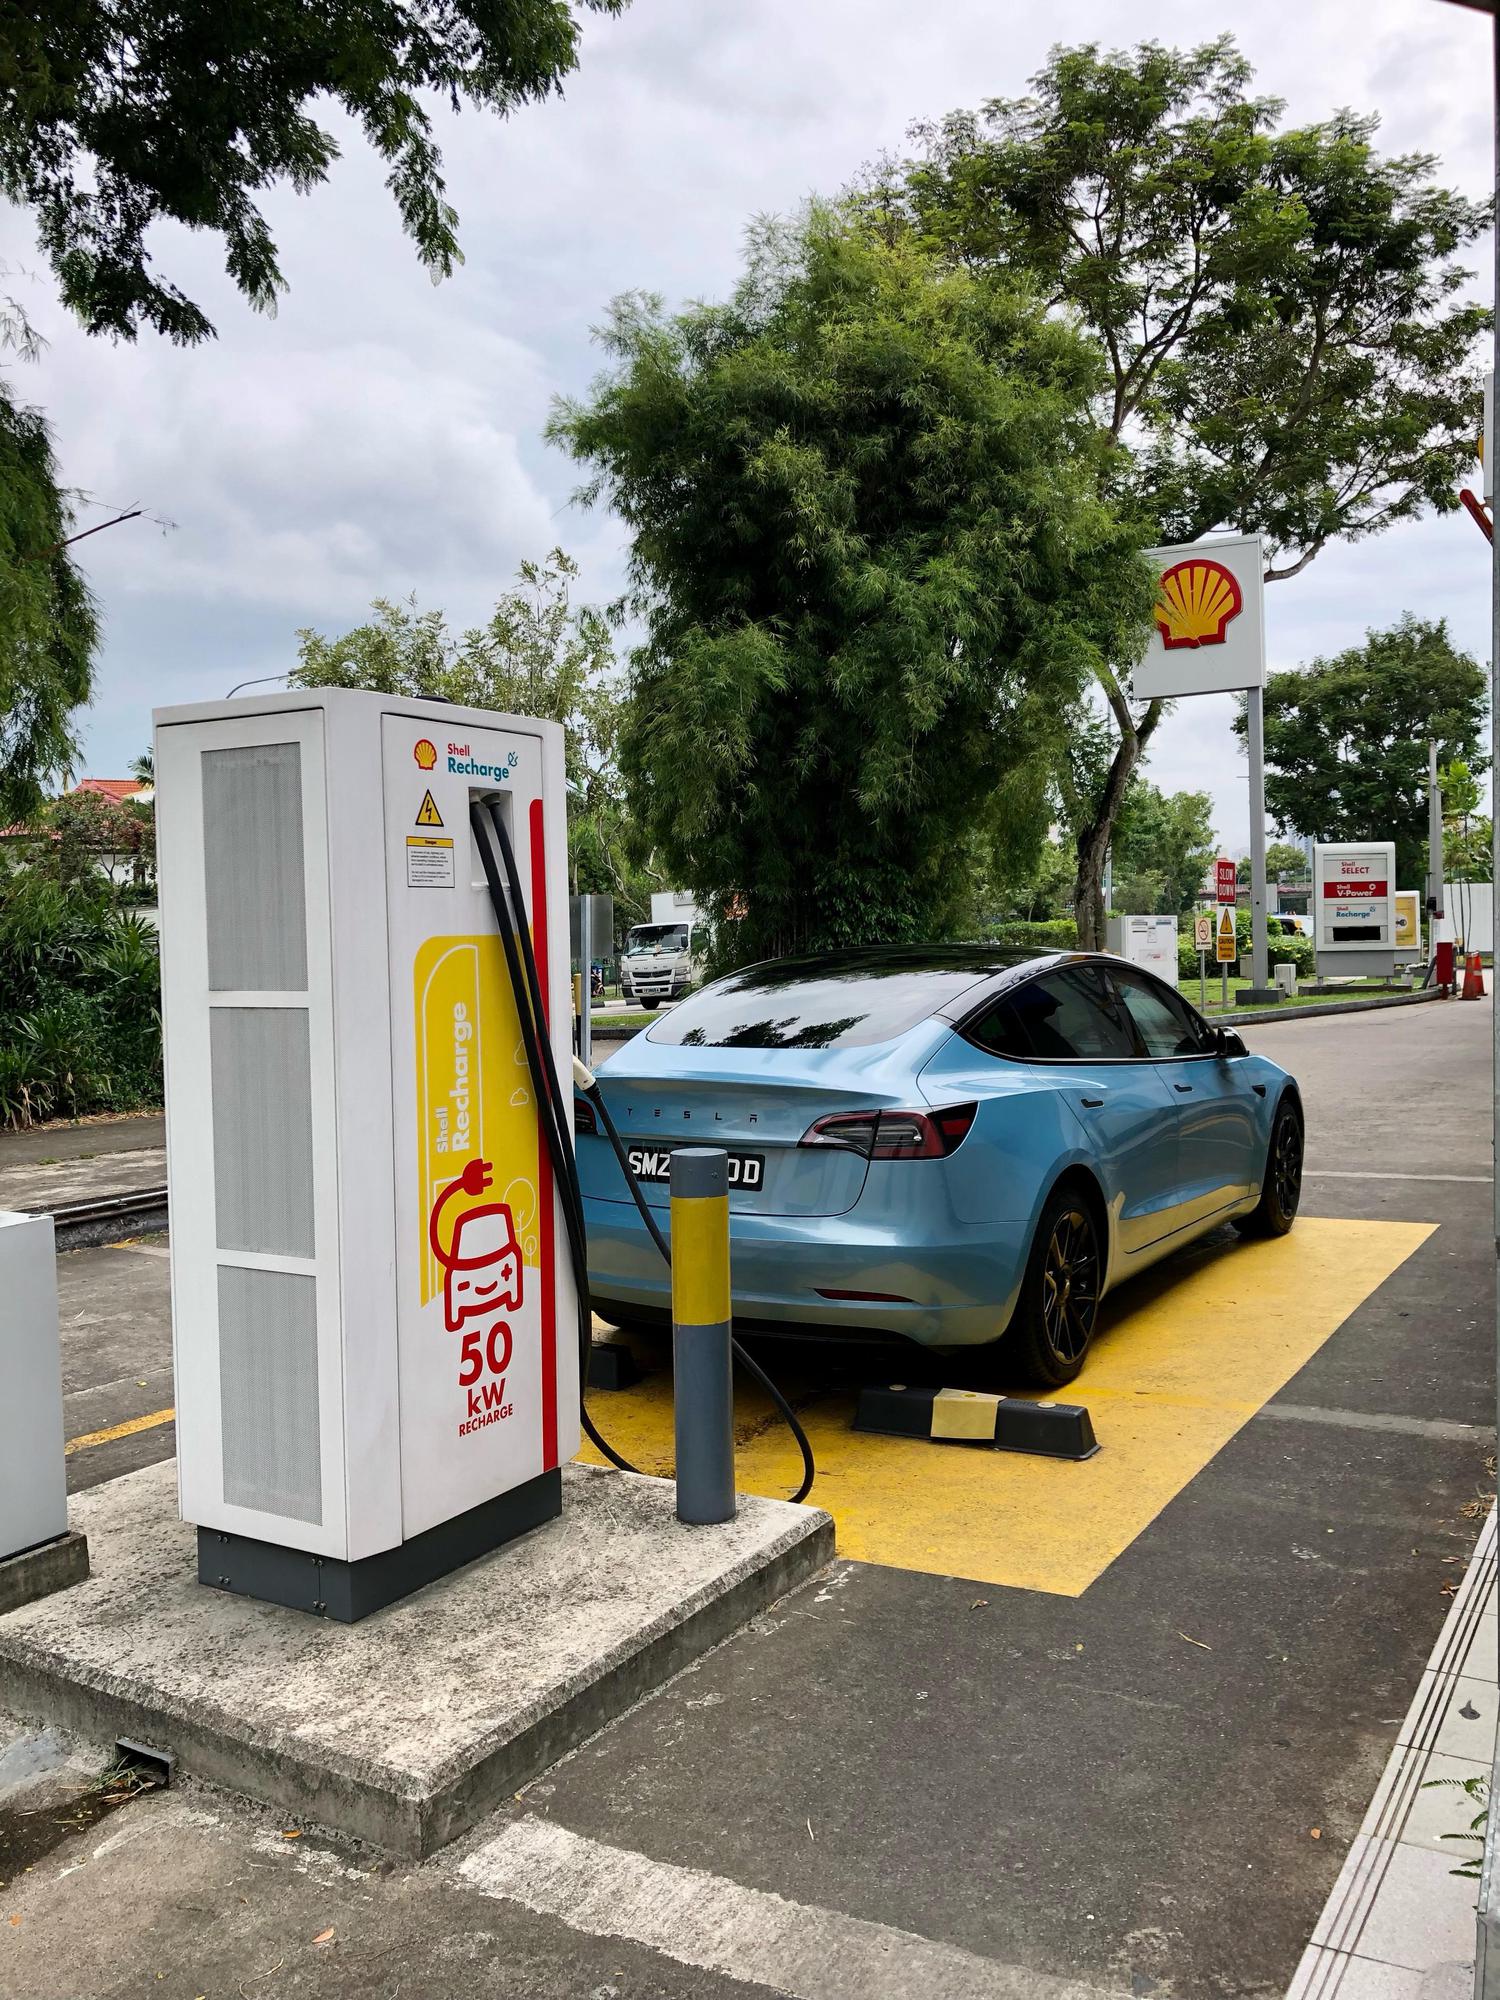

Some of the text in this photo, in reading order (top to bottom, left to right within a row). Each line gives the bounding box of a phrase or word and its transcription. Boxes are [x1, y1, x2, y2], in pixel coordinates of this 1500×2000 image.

[447, 743, 470, 757] Shell
[447, 757, 510, 782] Recharge
[1219, 868, 1234, 881] SLOW
[1341, 866, 1370, 875] SELECT
[1219, 883, 1235, 897] DOWN
[1336, 889, 1373, 897] V-Power
[1336, 911, 1371, 919] Recharge
[449, 1002, 473, 1152] Recharge
[627, 1107, 758, 1123] TESLA
[435, 1106, 449, 1153] Shell
[458, 1320, 513, 1387] 50
[467, 1377, 506, 1418] kW
[459, 1403, 513, 1438] RECHARGE
